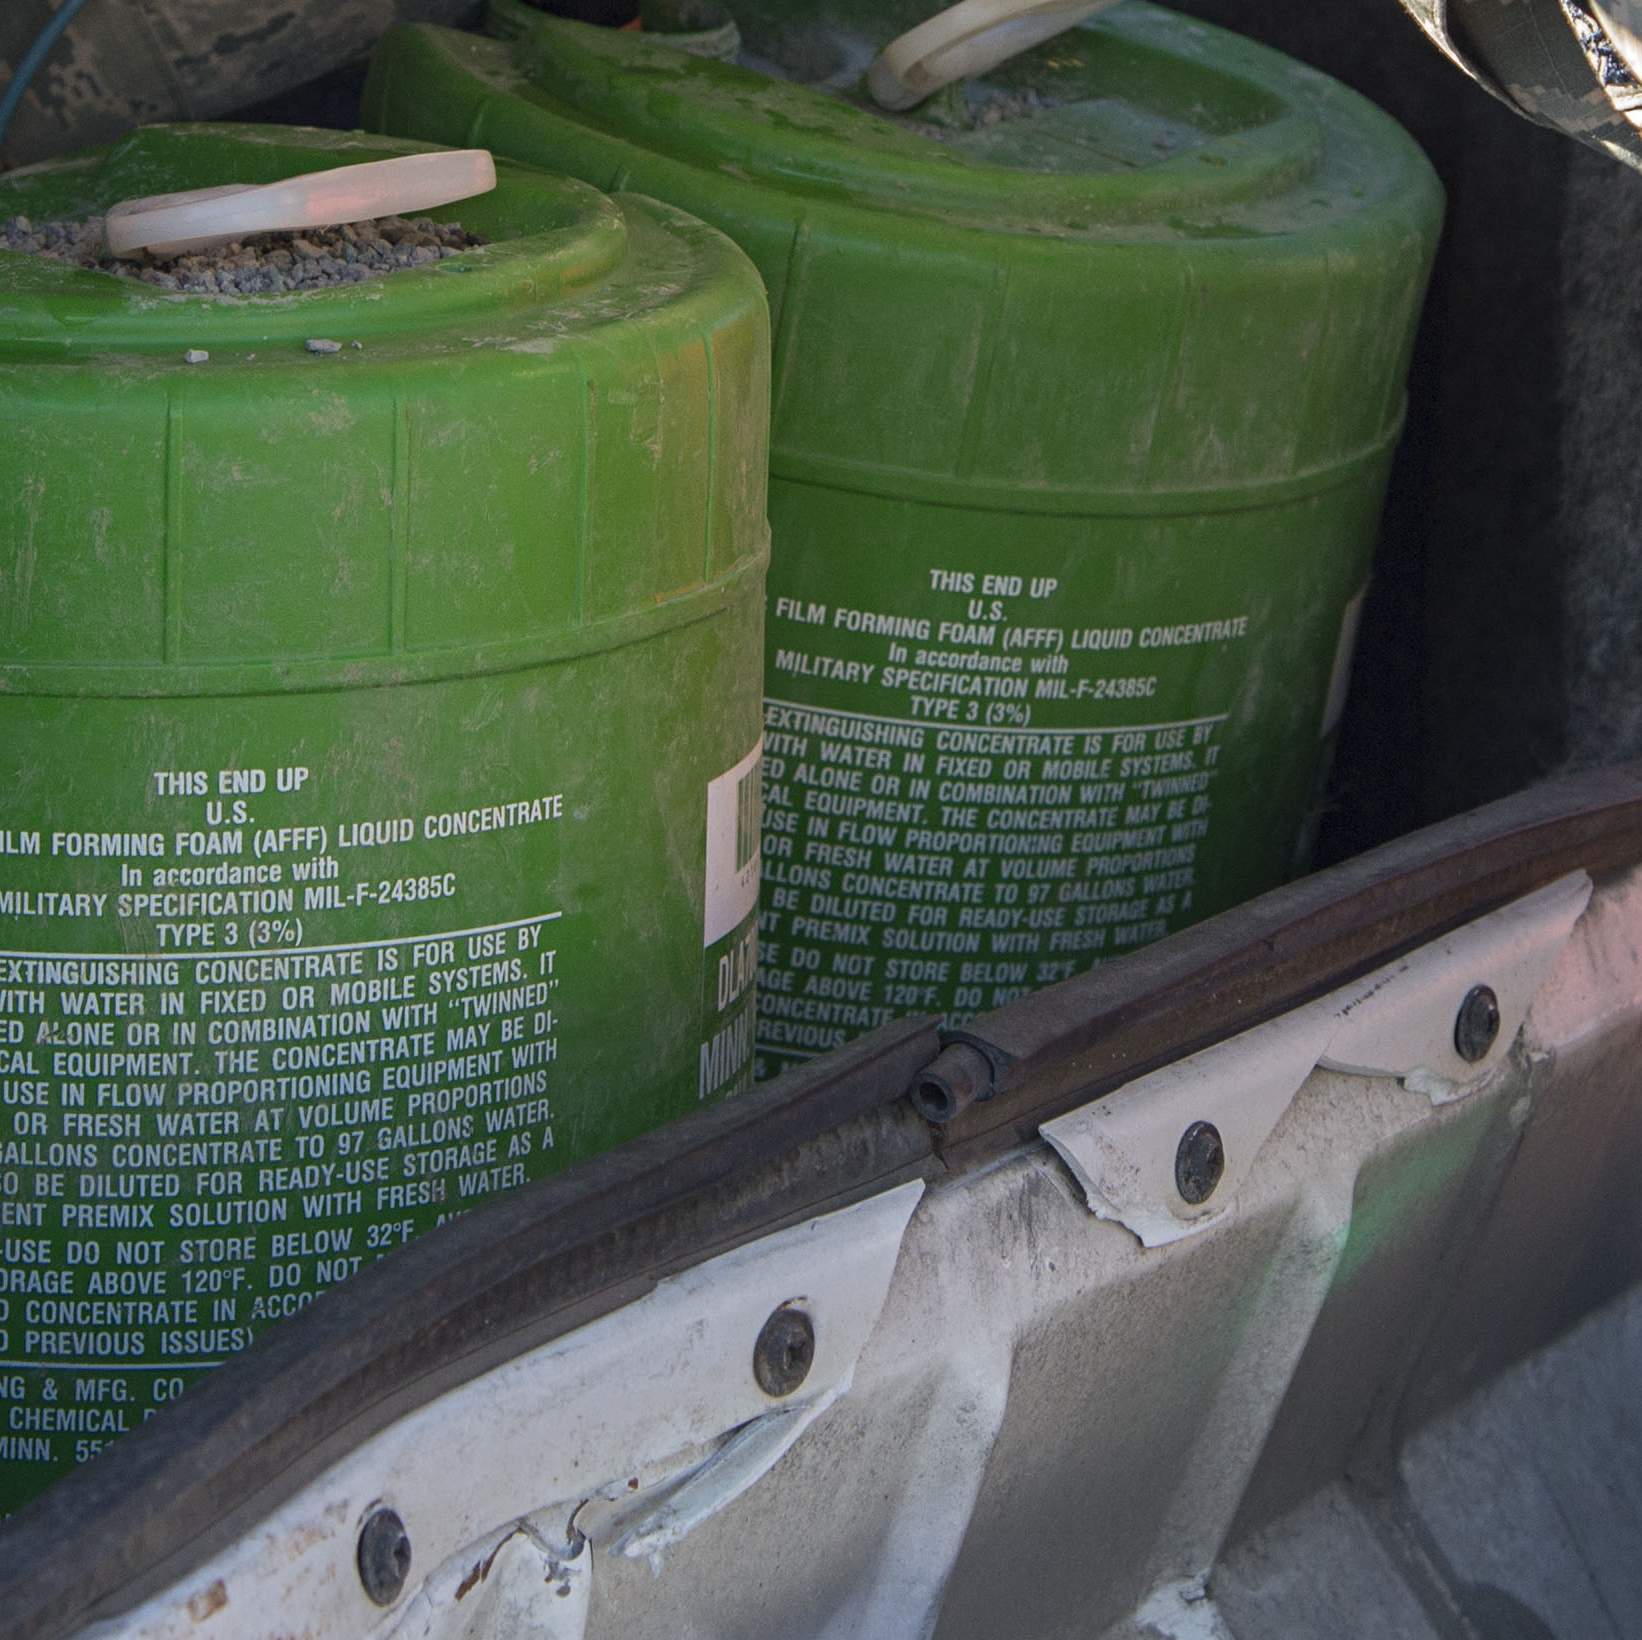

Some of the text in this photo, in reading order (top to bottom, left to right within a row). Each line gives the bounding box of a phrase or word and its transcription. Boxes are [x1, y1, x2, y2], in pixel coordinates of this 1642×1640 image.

[930, 569, 1058, 598] THIS END UP
[776, 598, 1248, 649] FILM FORMING FOAM (AFFF) LIQUID CONCENTRATE
[968, 599, 1007, 621] U.S.
[776, 651, 1157, 698] MILITARY SPECIFICATION MIL-F-24385C
[889, 643, 1068, 673] In accordance with
[765, 707, 924, 749] EXTINGUISHING
[937, 732, 1073, 754] CONCENTRATE
[1084, 735, 1101, 753] IS
[1112, 733, 1146, 752] FOR
[911, 695, 1030, 725] TYPE 3 (3%)
[153, 765, 310, 796] THIS END UP
[821, 741, 891, 769] WATER
[903, 753, 925, 773] IN
[936, 756, 992, 777] FIXED
[1004, 760, 1031, 779] OR
[1042, 759, 1111, 779] MOBILE
[52, 831, 165, 858] FORMING
[175, 829, 244, 857] FOAM
[253, 824, 328, 856] (AFFF)
[338, 816, 415, 848] LIQUID
[423, 792, 564, 840] CONCENTRATE
[206, 798, 256, 826] U.S.
[121, 855, 340, 889] In accordance with
[117, 888, 294, 918] SPECIFICATION
[304, 870, 456, 911] MIL-F-24385C
[155, 918, 303, 949] TYPE 3 (3%)
[195, 950, 364, 986] CONCENTRATE
[377, 946, 399, 973] IS
[412, 938, 455, 969] FOR
[468, 930, 507, 961] USE
[517, 922, 542, 952] BY
[60, 990, 146, 1017] WATER
[160, 990, 185, 1016] IN
[200, 987, 267, 1016] FIXED
[282, 984, 315, 1012] OR
[330, 973, 416, 1008] MOBILE
[428, 956, 528, 996] SYSTEMS.
[539, 948, 557, 977] IT
[35, 1019, 115, 1047] ALONE
[126, 1020, 161, 1047] OR
[172, 1020, 197, 1047] IN
[208, 1008, 371, 1045] COMBINATION
[381, 1000, 438, 1031] WITH
[53, 1050, 200, 1078] EQUIPMENT.
[214, 1048, 260, 1075] THE
[271, 1031, 436, 1072] CONCENTRATE
[446, 1023, 491, 1053] MAY
[501, 1017, 524, 1044] BE
[533, 1012, 559, 1036] DI-
[3, 1078, 50, 1106] USE
[61, 1081, 86, 1108] IN
[97, 1081, 167, 1107] FLOW
[177, 1068, 371, 1107] PROPORTIONING
[382, 1047, 504, 1091] EQUIPMENT
[511, 1036, 558, 1070] WITH
[13, 1109, 49, 1136] OR
[63, 1111, 141, 1138] FRESH
[156, 1109, 240, 1138] WATER
[254, 1106, 285, 1133] AT
[297, 1095, 394, 1130] VOLUME
[407, 1068, 547, 1118] PROPORTIONS
[35, 1171, 65, 1197] BE
[79, 1172, 181, 1198] DILUTED
[196, 1169, 243, 1196] FOR
[258, 1155, 390, 1193] READY-USE
[403, 1137, 497, 1178] STORAGE
[507, 1130, 532, 1159] AS
[542, 1124, 554, 1151] A
[62, 1202, 155, 1229] PREMIX
[169, 1198, 288, 1228] SOLUTION
[302, 1190, 362, 1219] WITH
[376, 1177, 446, 1211] FRESH
[458, 1161, 531, 1198] WATER.
[67, 1239, 101, 1265] DO
[116, 1239, 165, 1265] NOT
[179, 1235, 257, 1264] STORE
[271, 1225, 353, 1258] BELOW
[25, 1329, 145, 1356] PREVIOUS
[42, 1376, 58, 1401] &
[75, 1377, 135, 1403] MFG.
[9, 1405, 130, 1433] CHEMICAL
